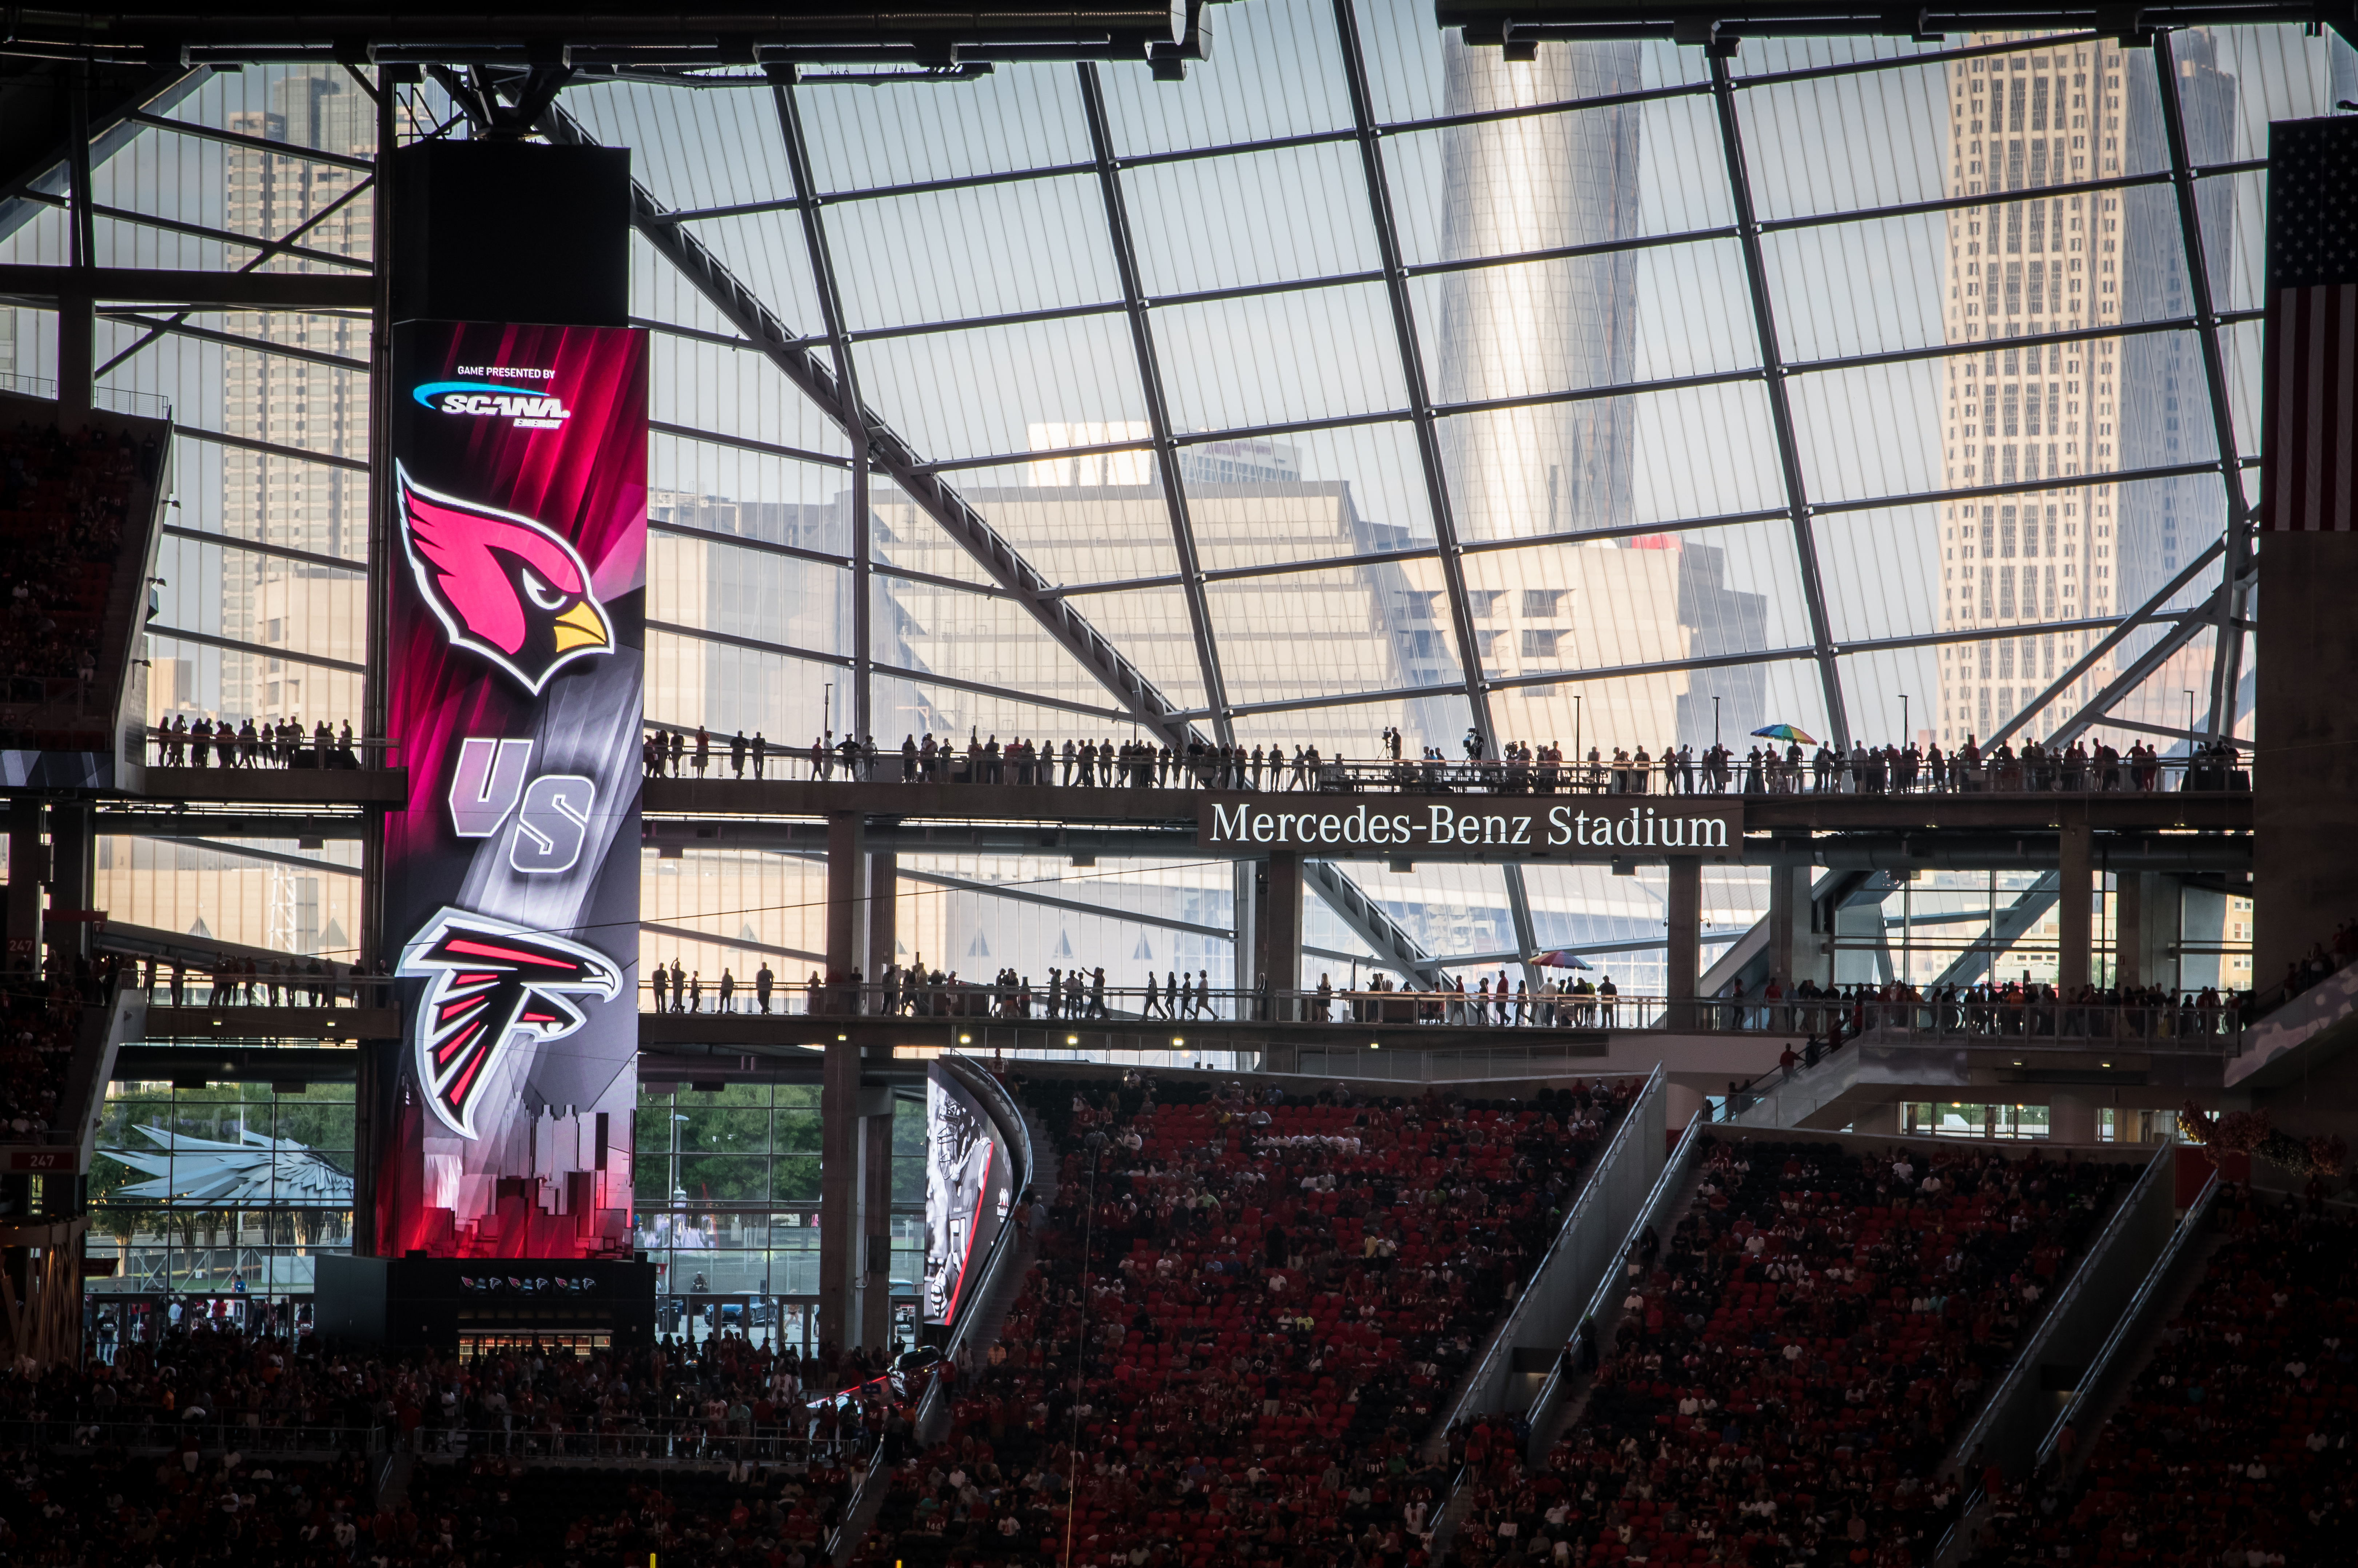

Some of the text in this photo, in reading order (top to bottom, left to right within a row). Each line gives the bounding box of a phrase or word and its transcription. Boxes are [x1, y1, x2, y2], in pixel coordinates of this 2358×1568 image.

[458, 366, 555, 379] GAME PRESENTED BY
[441, 394, 563, 418] SCANA
[514, 418, 563, 429] ENERGY
[1209, 804, 1729, 847] Mercedes-Benz Stadium
[9, 939, 32, 951] 247
[30, 1155, 54, 1167] 247
[1145, 1210, 1151, 1218] 11
[1171, 1238, 1175, 1246] 11
[1692, 1281, 1697, 1289] 11
[1382, 1287, 1387, 1295] 11
[2004, 1302, 2009, 1310] 11
[1220, 1427, 1227, 1435] 2
[1557, 1456, 1561, 1465] 2
[2033, 1471, 2039, 1479] 2
[1298, 1490, 1302, 1498] 2
[2033, 1519, 2040, 1528] 11
[341, 1530, 347, 1540] 7
[1347, 1534, 1353, 1543] 11
[1918, 1530, 1923, 1538] 11
[2038, 1549, 2044, 1557] 11
[1879, 1556, 1884, 1565] 11
